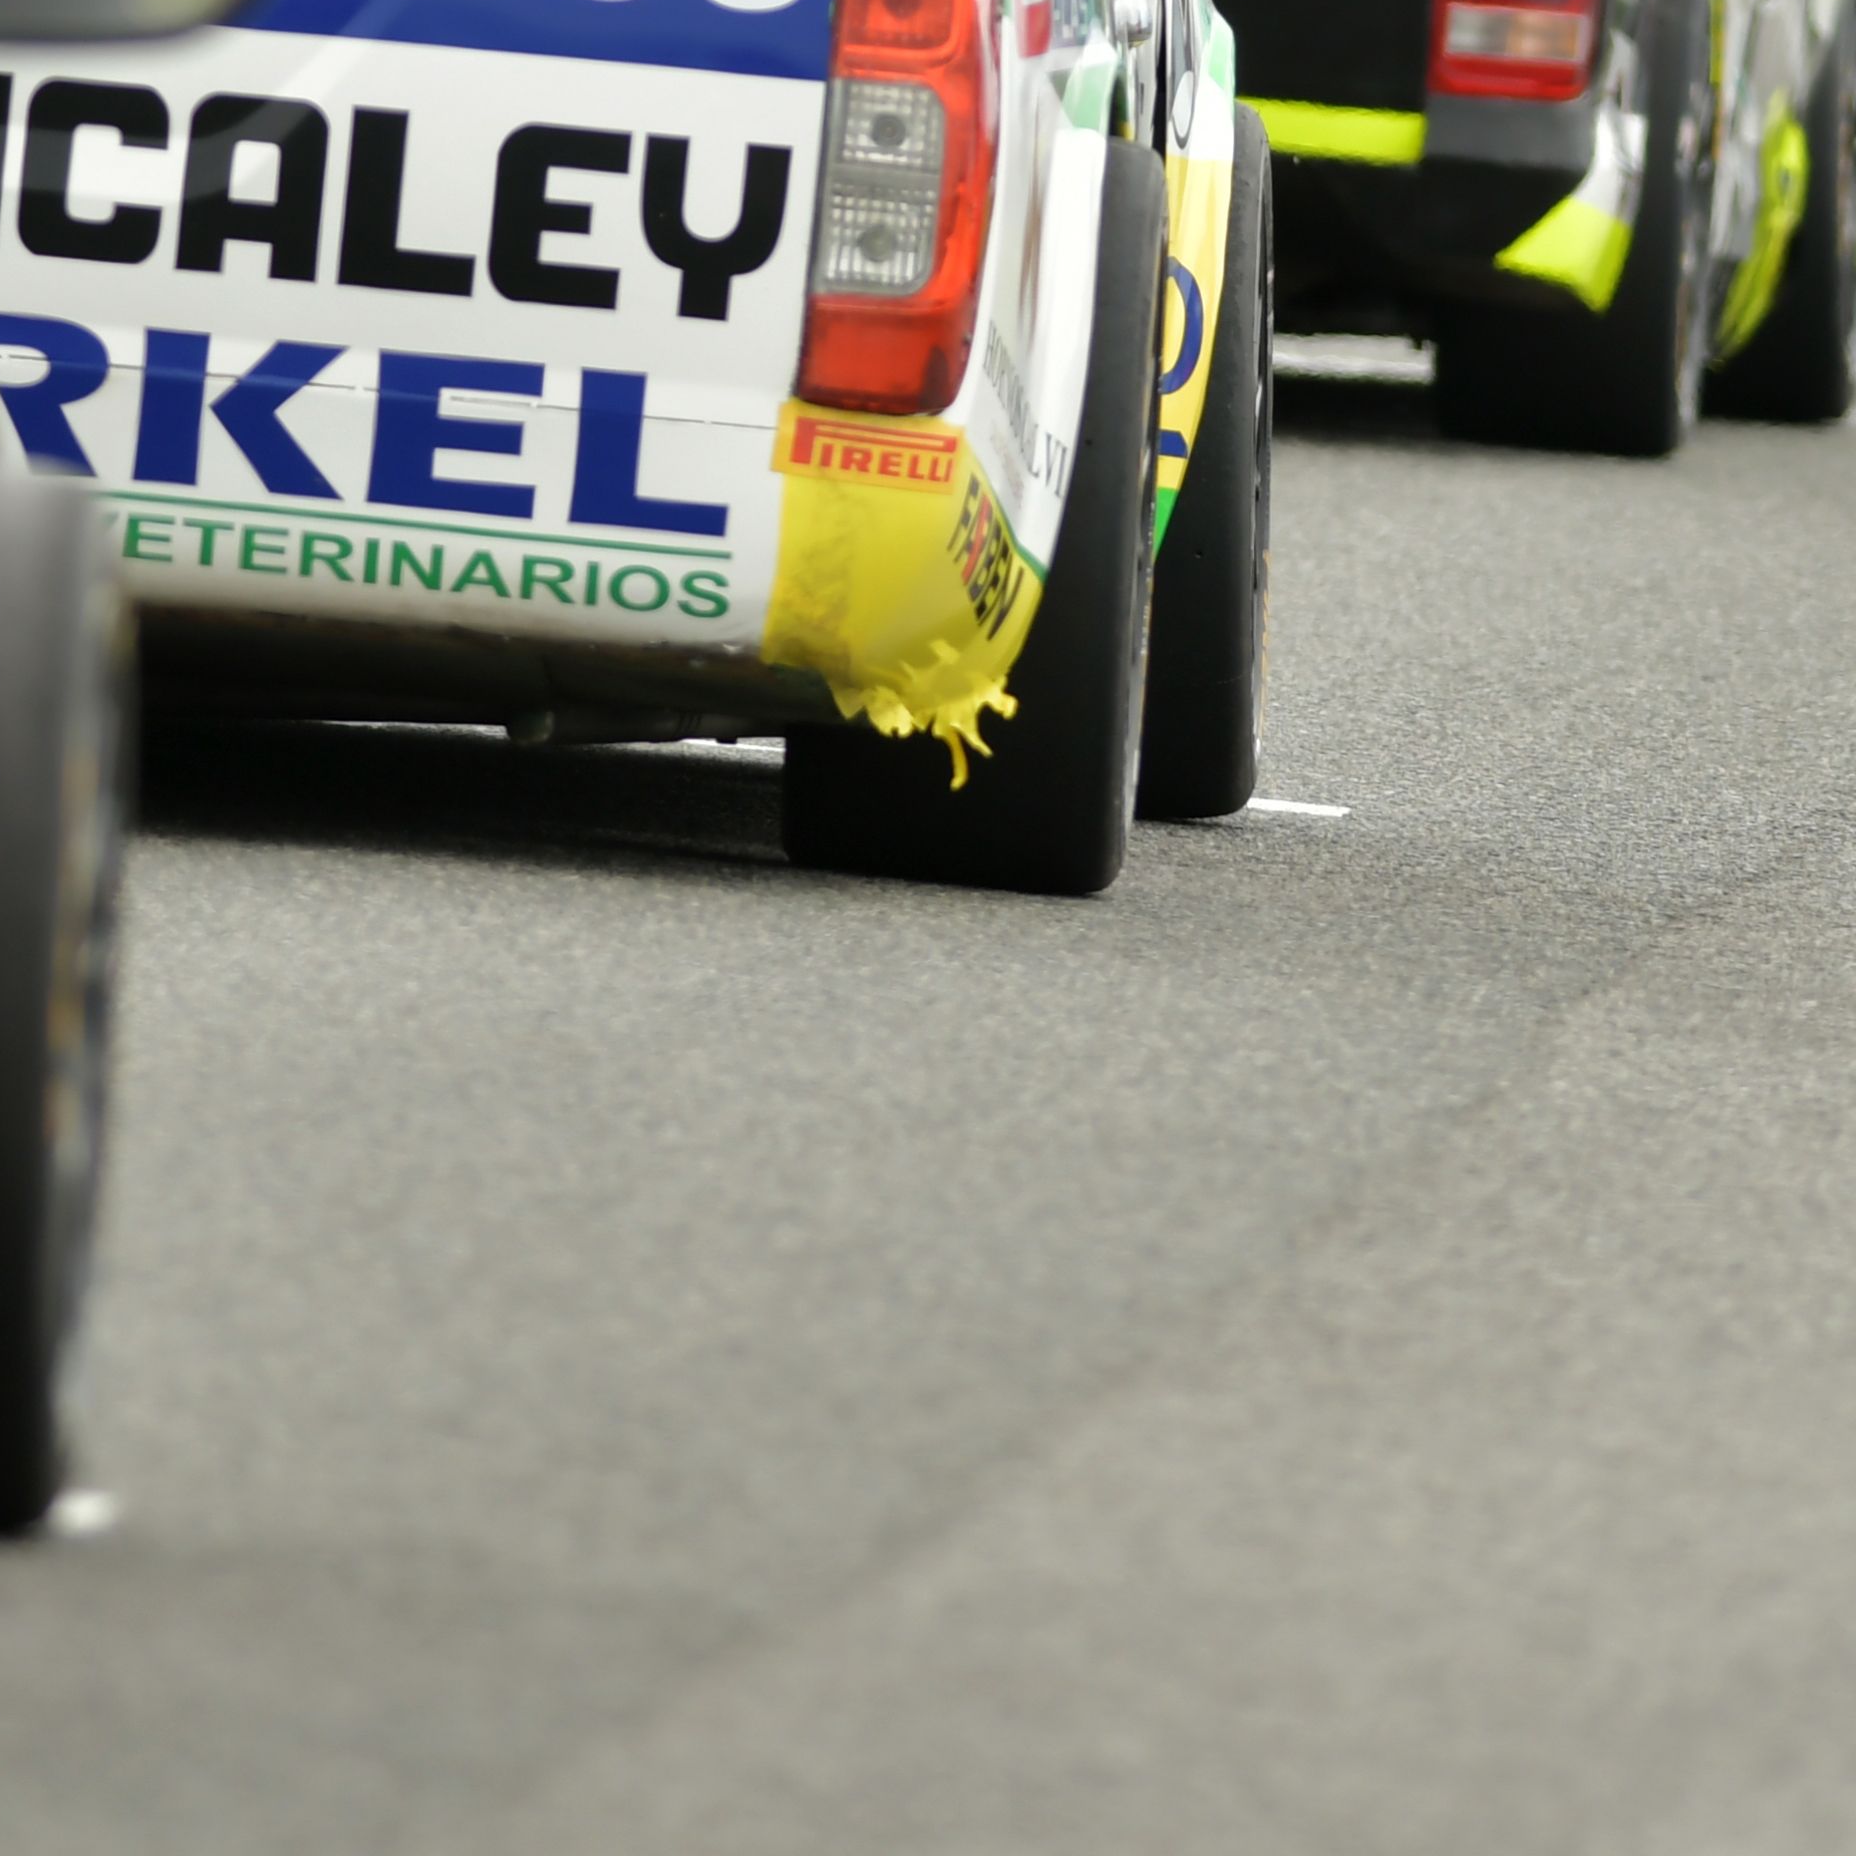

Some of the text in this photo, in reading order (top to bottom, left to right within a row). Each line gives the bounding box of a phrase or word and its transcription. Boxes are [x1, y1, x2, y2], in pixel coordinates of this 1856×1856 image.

[790, 416, 959, 483] PIRELLI
[97, 508, 732, 620] ETERINARIOS
[947, 472, 1025, 641] FABEN
